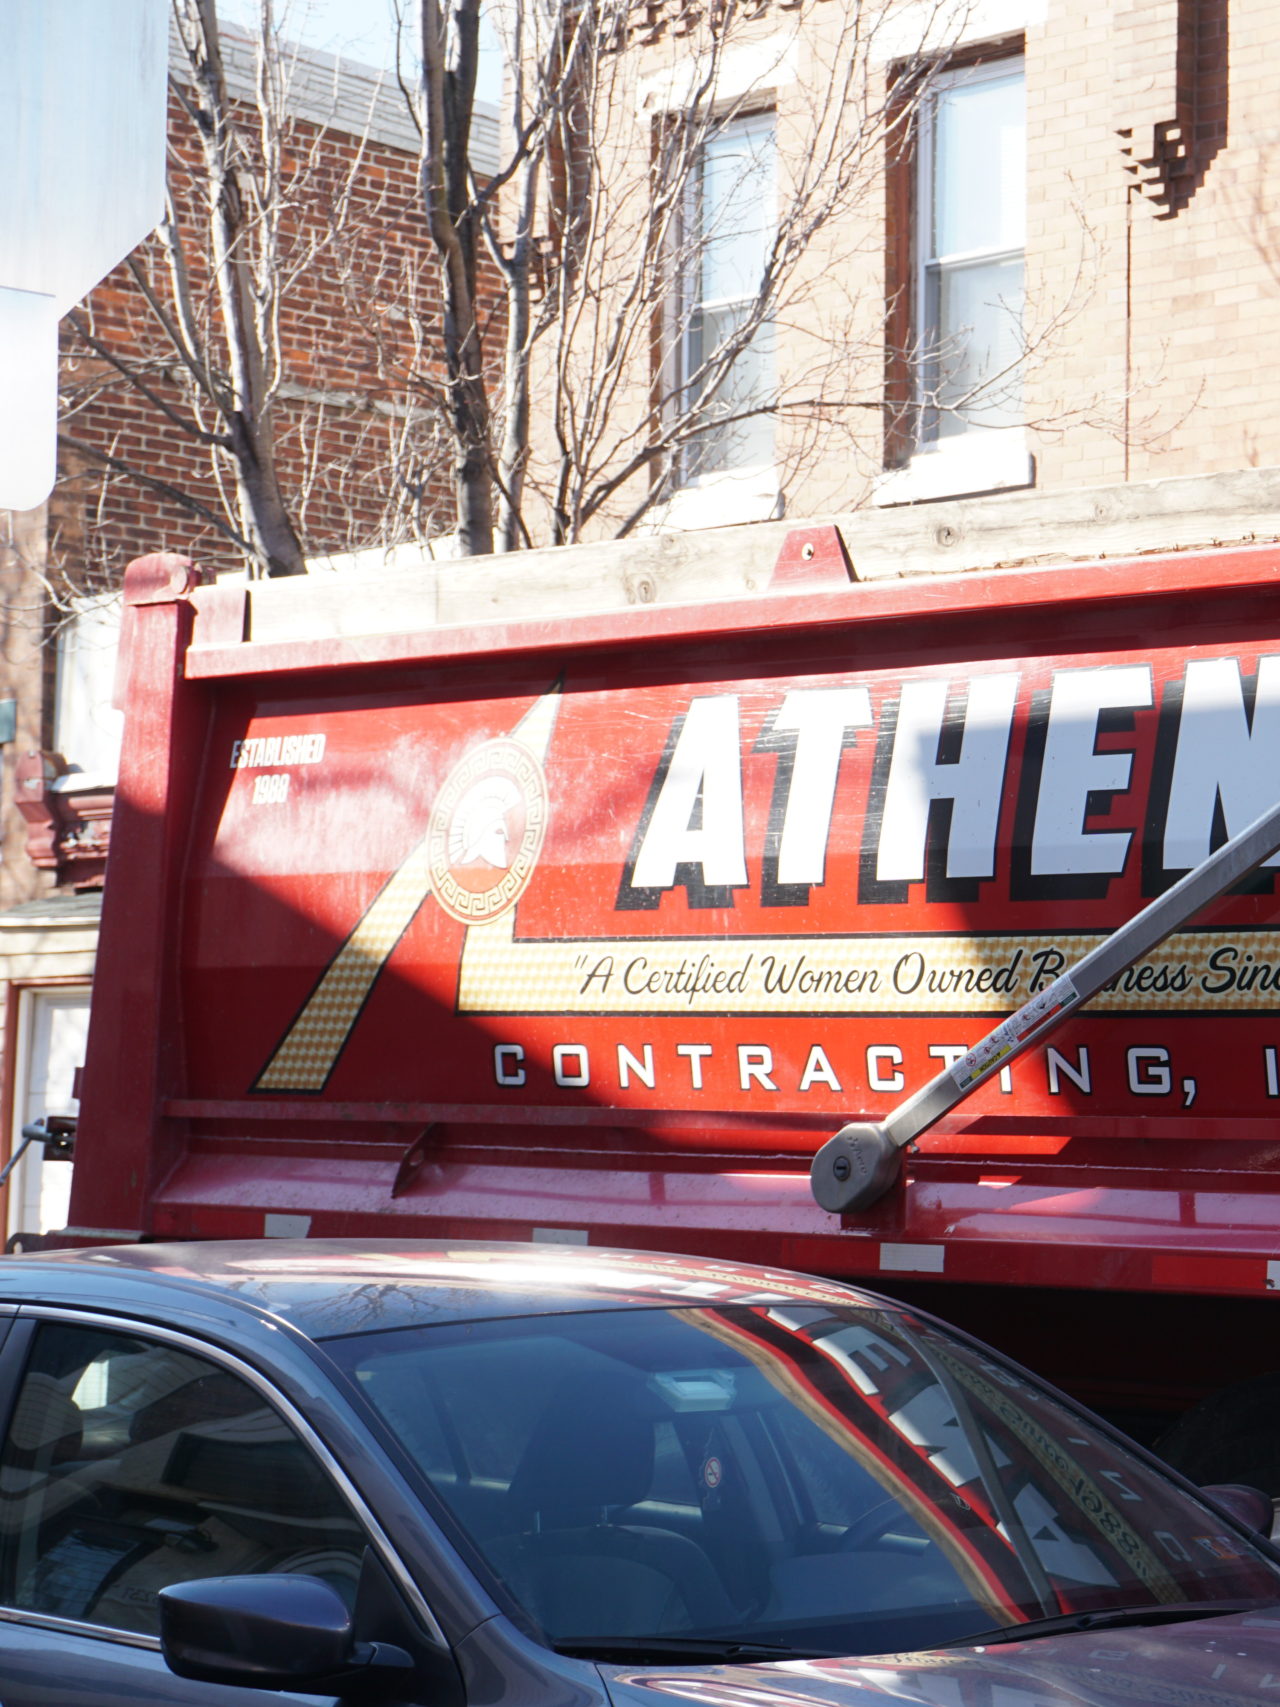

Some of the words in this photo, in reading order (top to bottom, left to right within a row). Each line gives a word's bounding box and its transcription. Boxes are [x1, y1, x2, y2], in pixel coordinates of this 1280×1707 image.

[230, 733, 326, 768] ESTABLISHED
[251, 773, 291, 804] 1988
[623, 952, 754, 1004] Certified
[760, 954, 882, 995] Women
[892, 948, 1024, 995] Owned
